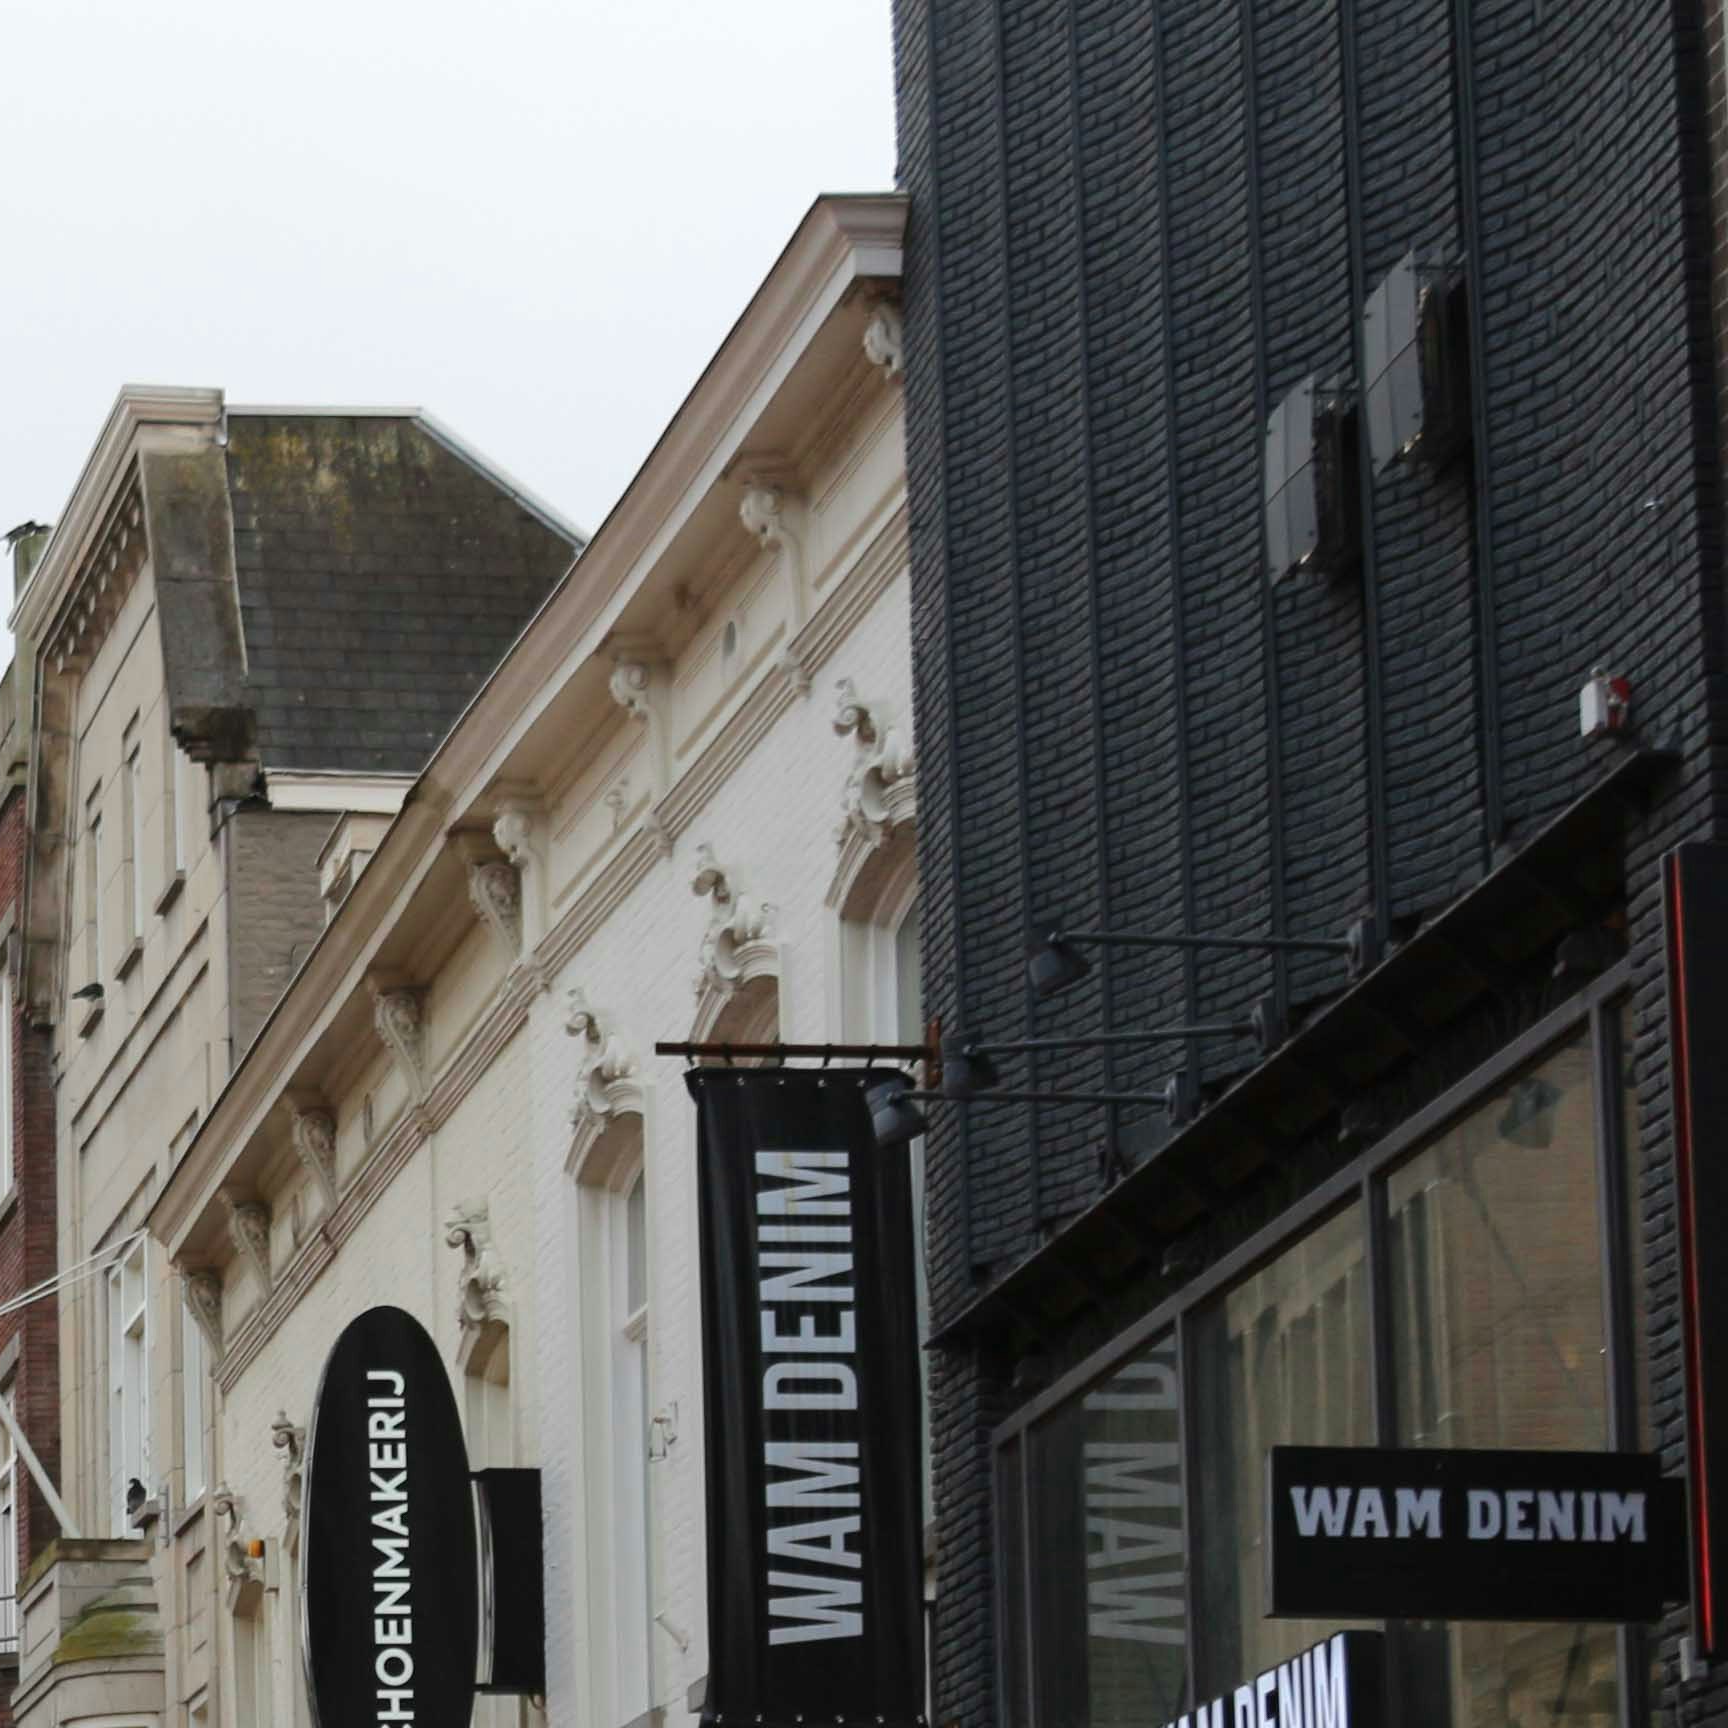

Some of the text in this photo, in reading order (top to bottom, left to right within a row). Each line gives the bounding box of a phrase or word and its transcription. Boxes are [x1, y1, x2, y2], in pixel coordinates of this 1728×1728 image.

[754, 1151, 863, 1646] WAM DENIM
[1290, 1486, 1646, 1542] WAM DENIM
